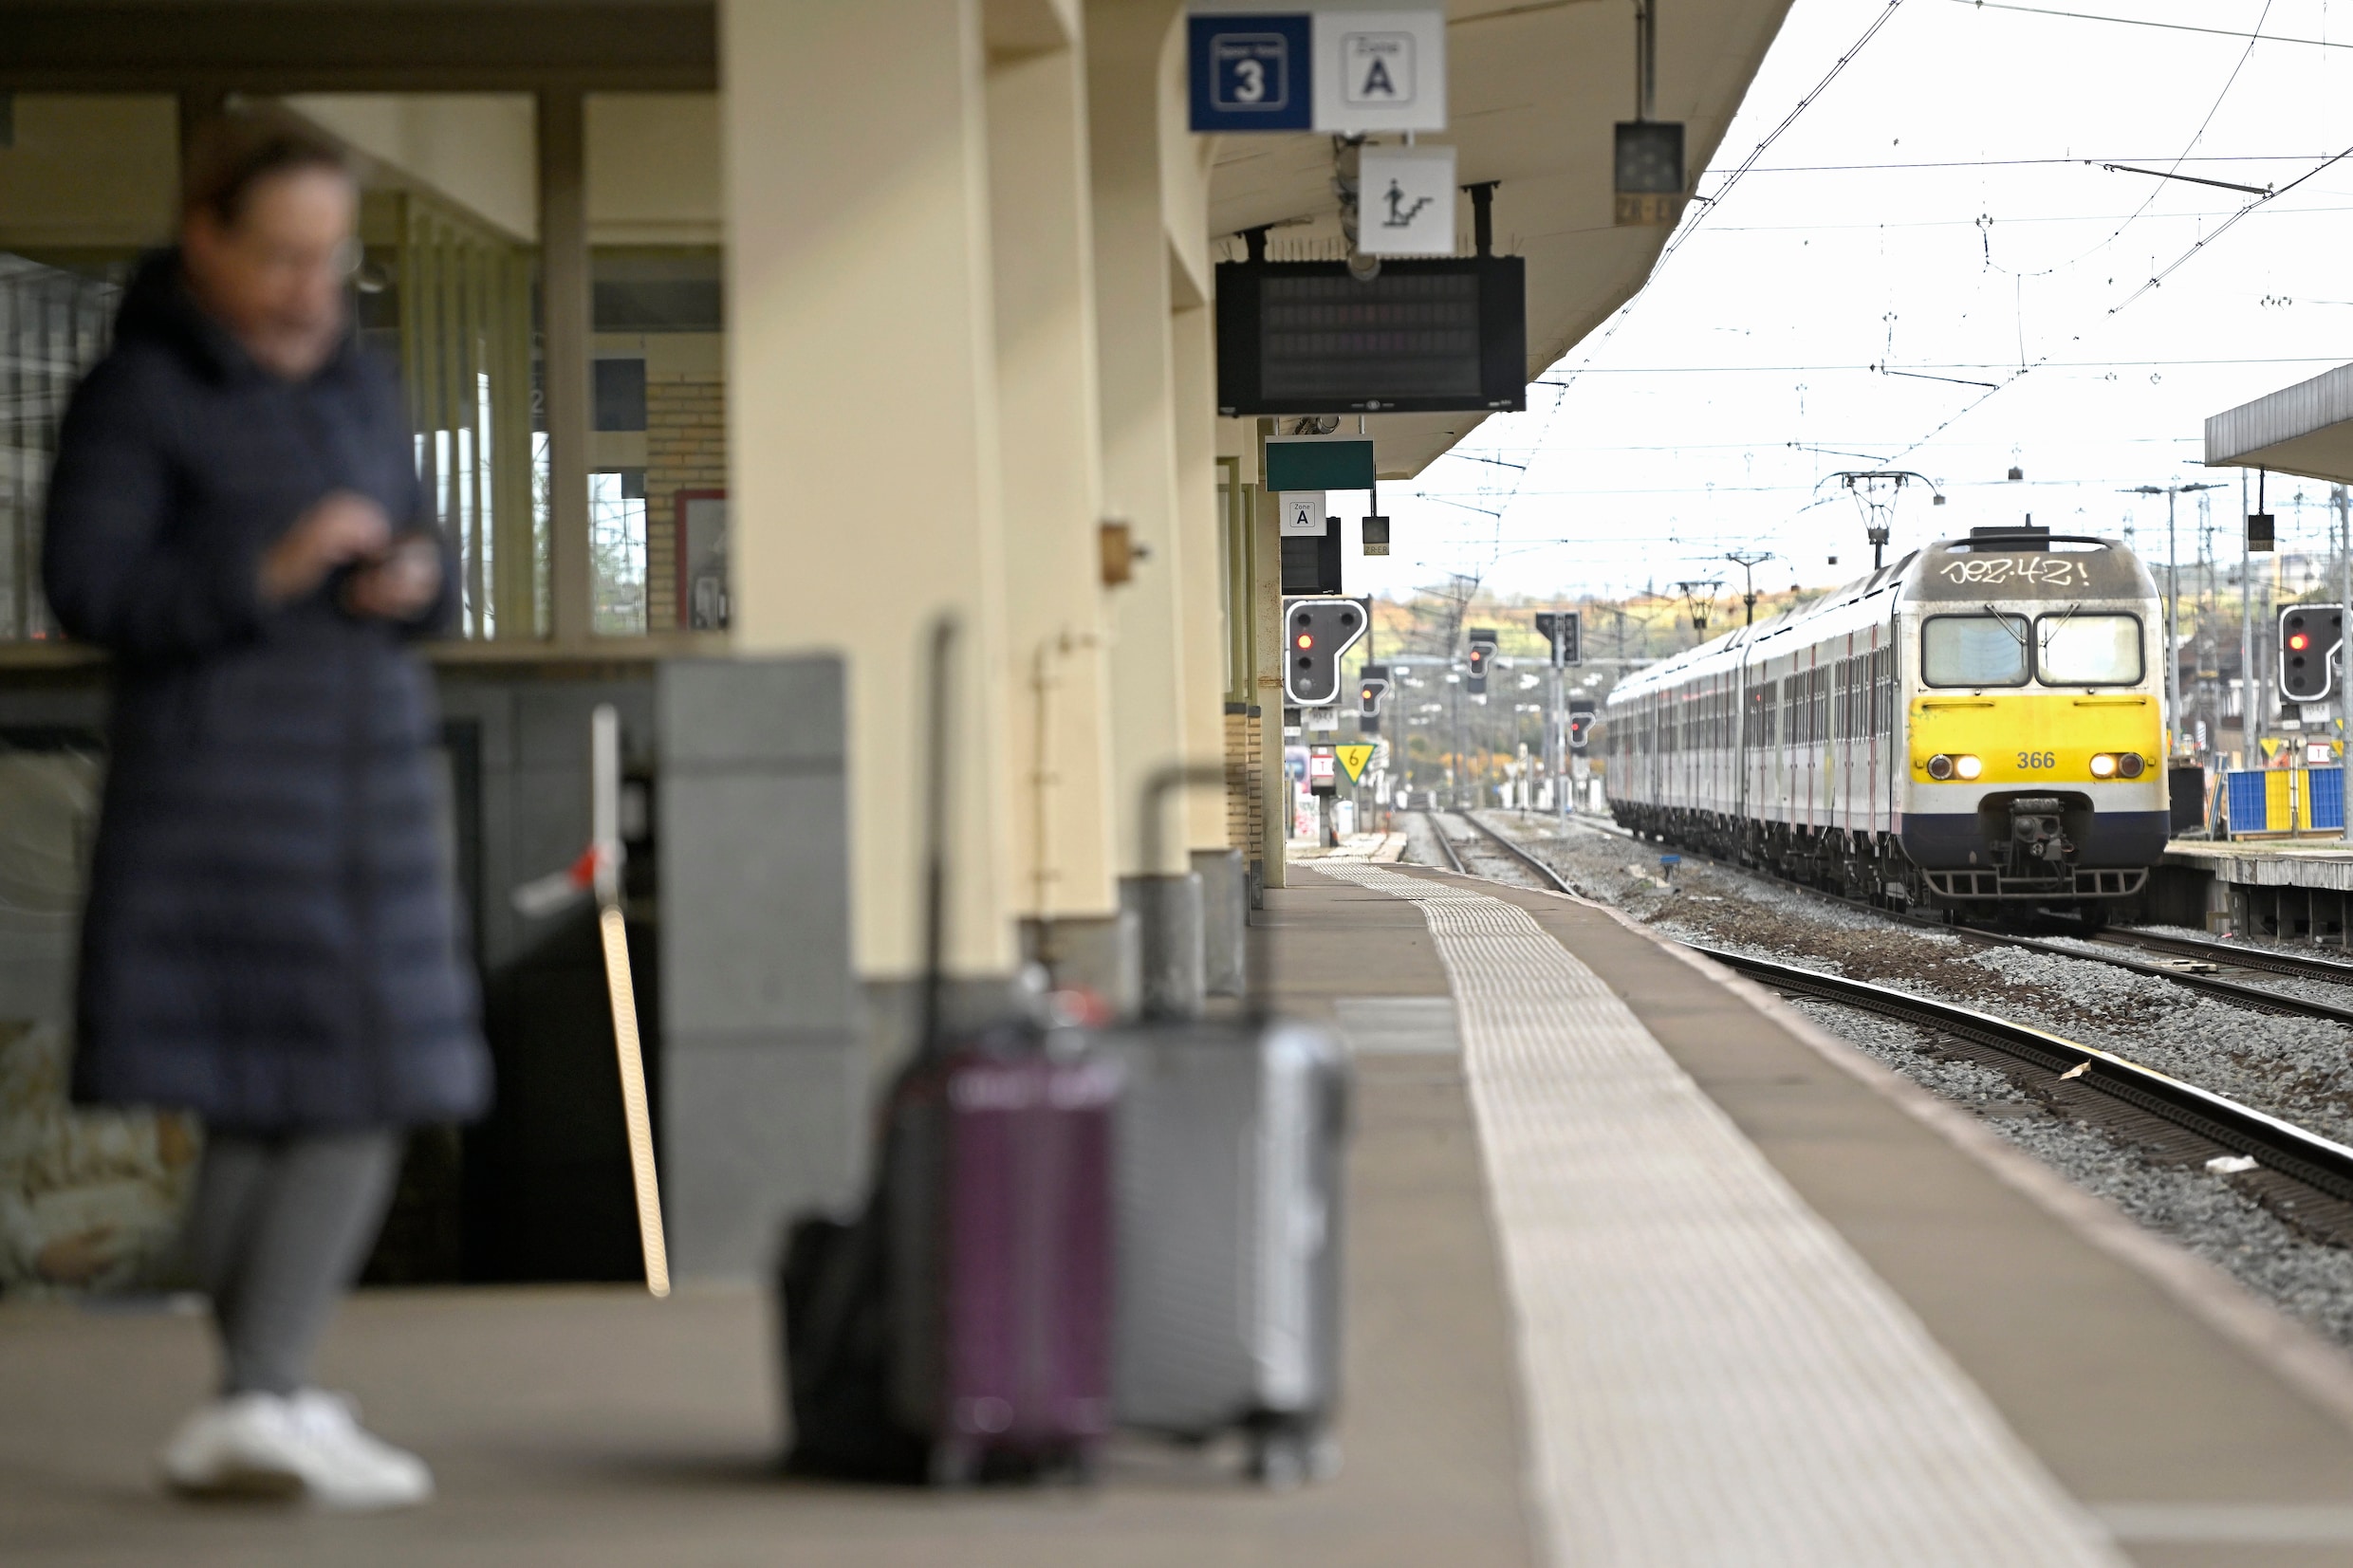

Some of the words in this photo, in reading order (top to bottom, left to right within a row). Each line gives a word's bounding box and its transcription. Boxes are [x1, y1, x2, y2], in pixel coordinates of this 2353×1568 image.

[1234, 59, 1265, 102] 3
[1362, 57, 1396, 96] A
[1296, 509, 1308, 525] A
[1348, 747, 1360, 766] 6
[2016, 751, 2056, 769] 366
